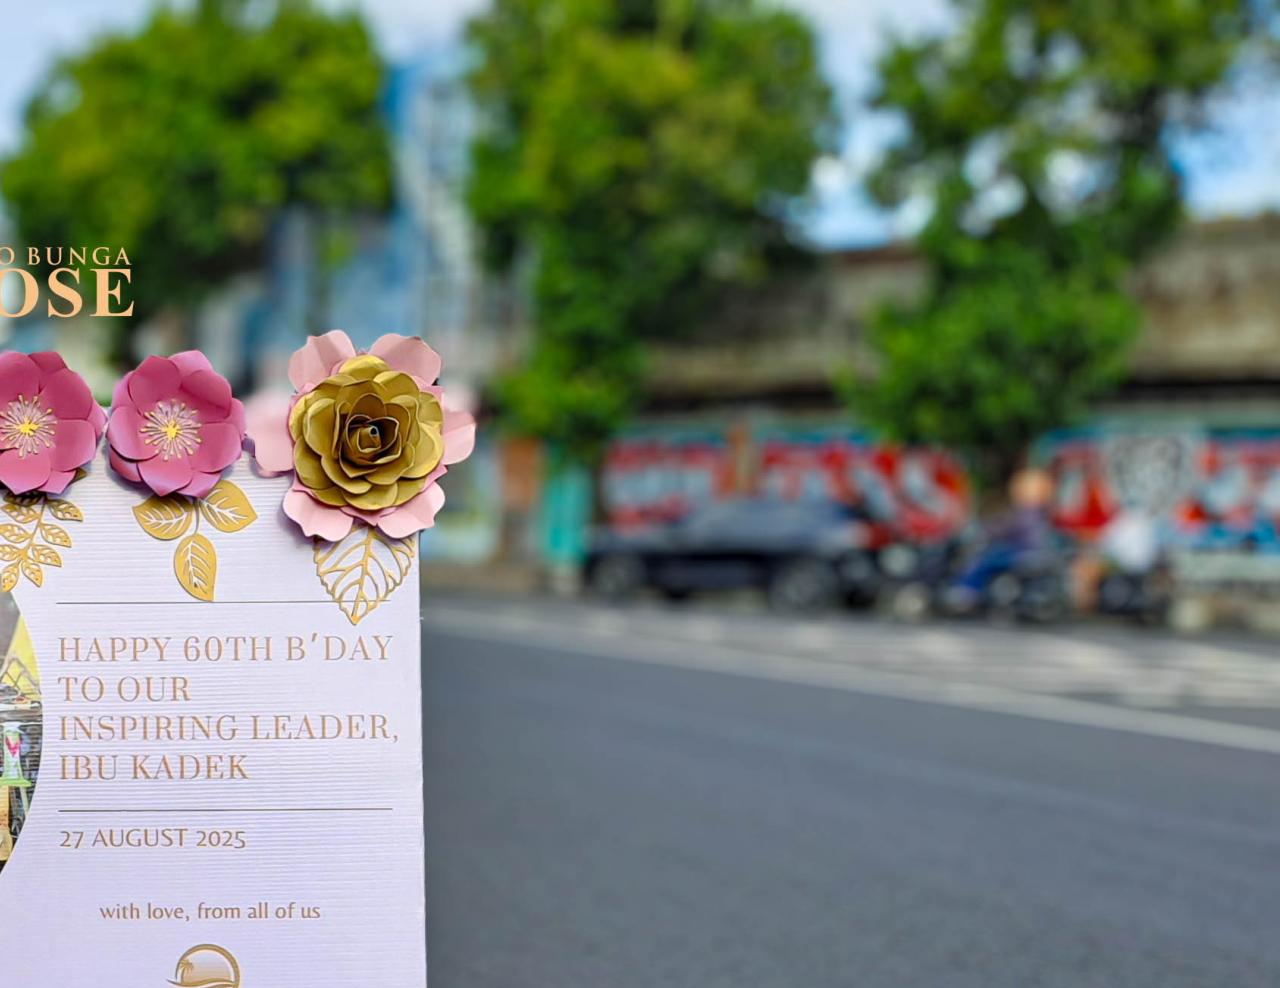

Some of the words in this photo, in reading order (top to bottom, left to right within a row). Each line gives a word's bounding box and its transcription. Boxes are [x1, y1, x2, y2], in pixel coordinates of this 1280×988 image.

[58, 636, 172, 662] HAPPY
[183, 635, 273, 662] 60TH
[285, 632, 394, 661] B'DAY
[58, 676, 105, 702] TO
[116, 676, 192, 702] OUR
[59, 715, 238, 741] INSPIRING
[250, 714, 399, 744] LEADER,
[59, 754, 118, 780] IBU
[131, 754, 249, 780] KADEK
[59, 830, 84, 849] 27
[92, 828, 188, 847] AUGUST
[196, 830, 246, 849] 2025
[100, 903, 141, 920] with
[147, 903, 190, 922] love,
[197, 903, 241, 920] from
[248, 902, 269, 919] all
[275, 902, 298, 920] of
[301, 908, 321, 919] us
